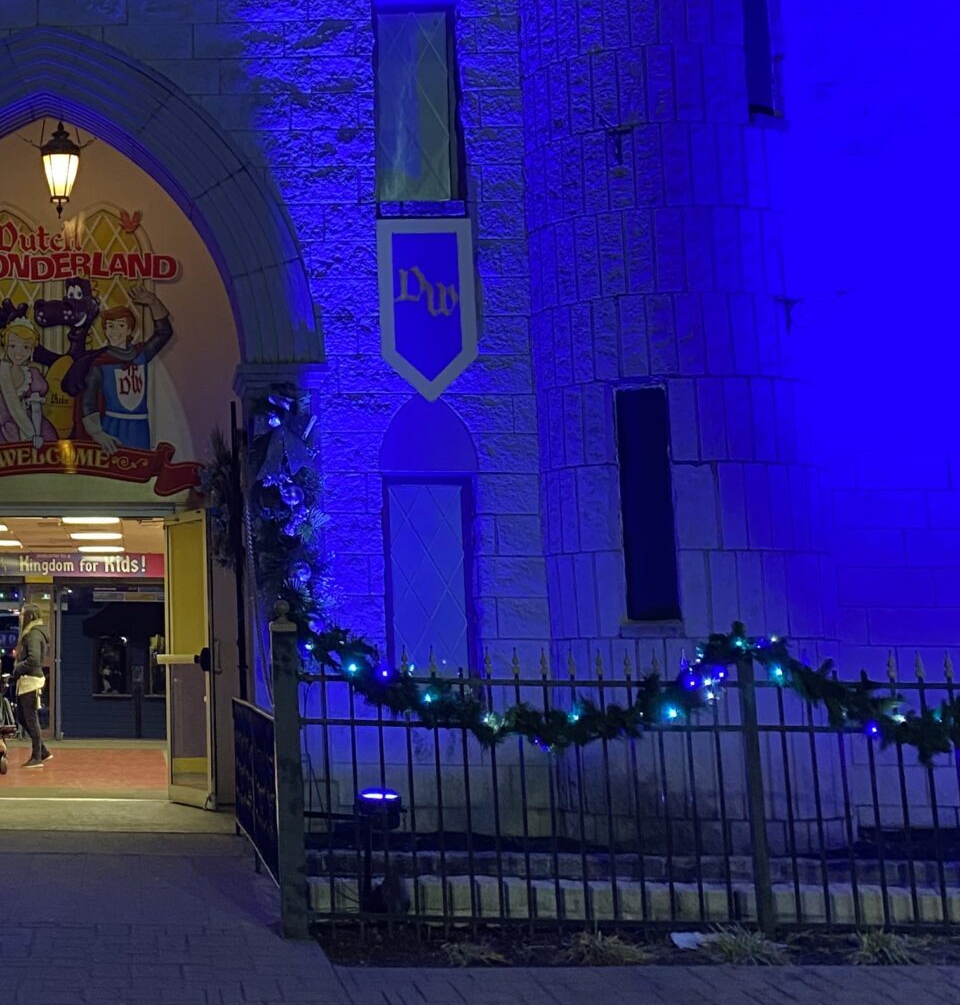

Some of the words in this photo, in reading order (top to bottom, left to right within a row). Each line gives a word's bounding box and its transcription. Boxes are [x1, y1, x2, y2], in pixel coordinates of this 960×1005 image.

[19, 555, 74, 575] Kingdom
[79, 558, 99, 572] for
[104, 555, 146, 573] Kids!
